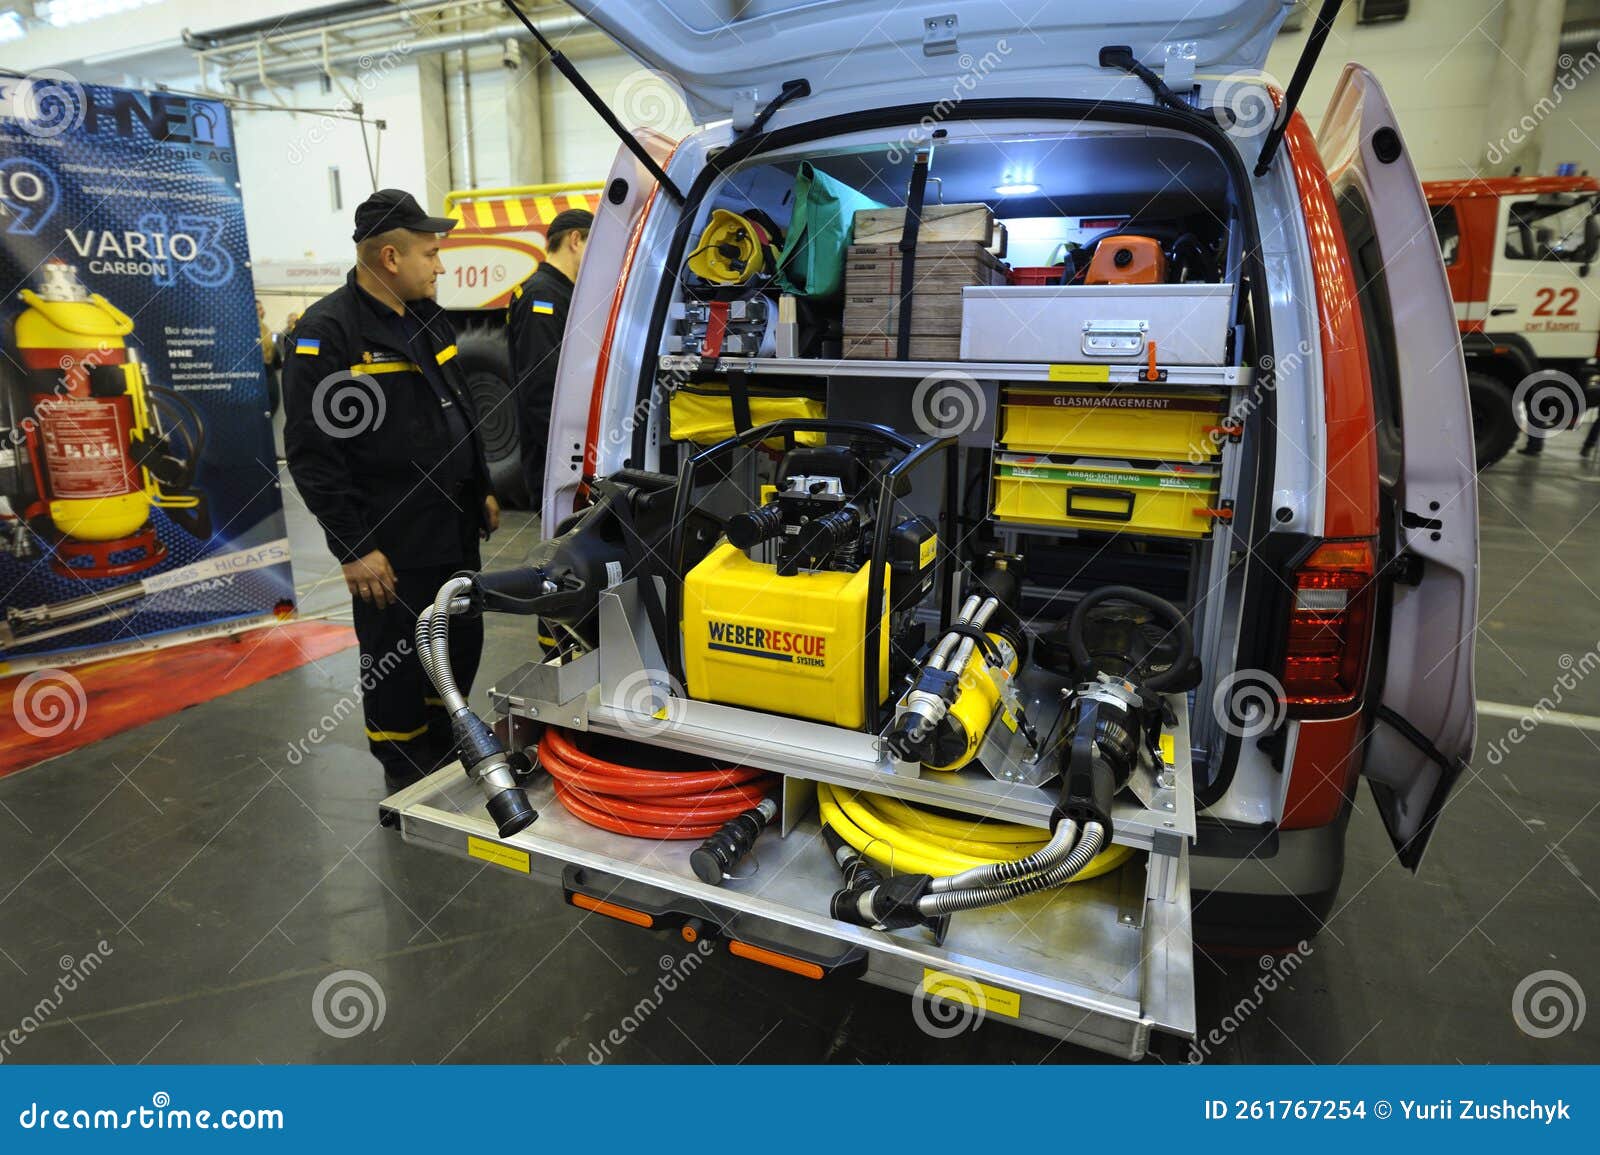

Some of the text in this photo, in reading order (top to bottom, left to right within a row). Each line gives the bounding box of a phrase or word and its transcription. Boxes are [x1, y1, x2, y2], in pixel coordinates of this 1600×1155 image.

[208, 151, 232, 163] AG
[65, 229, 198, 261] VARIO
[89, 261, 166, 276] CARBON
[454, 265, 488, 288] 101
[1532, 287, 1580, 317] 22
[1053, 396, 1169, 409] GLASMANAGEMENT
[184, 574, 236, 597] SPRAY
[797, 656, 825, 667] SYSTEMS
